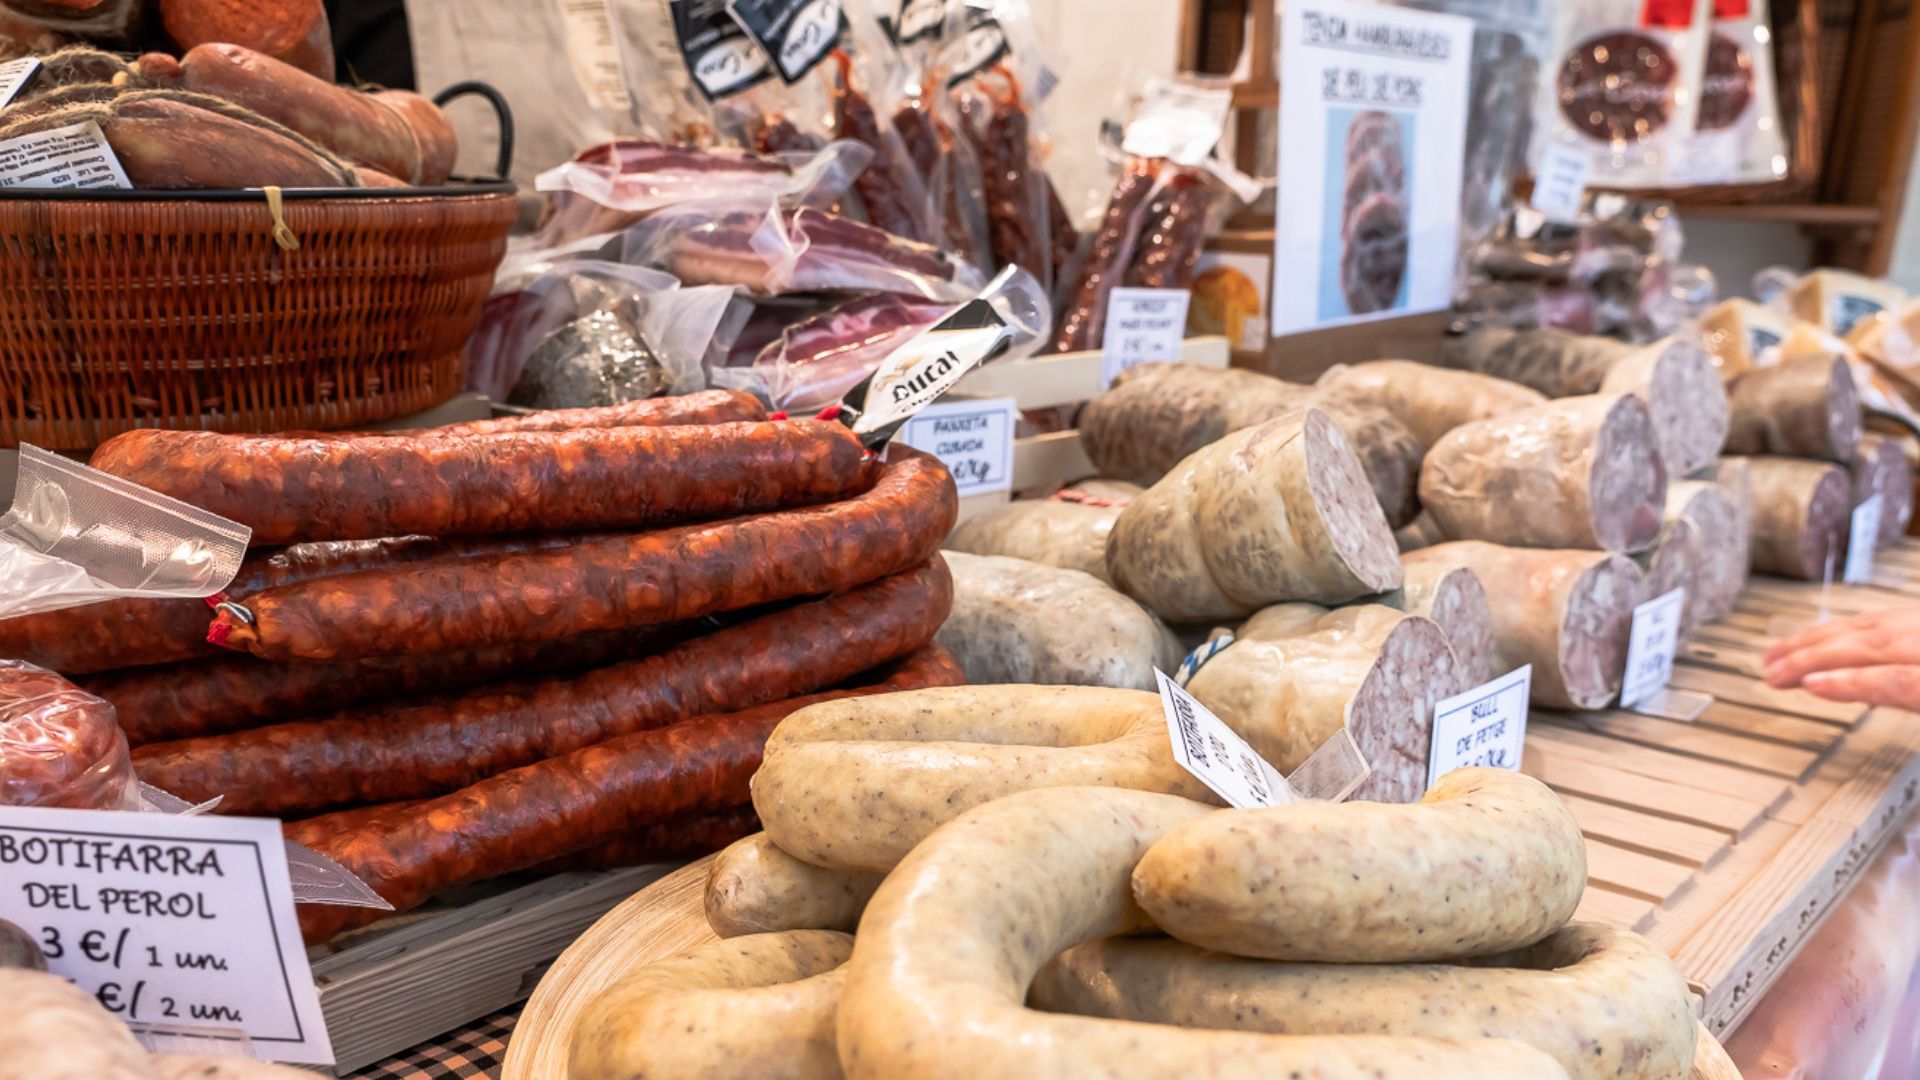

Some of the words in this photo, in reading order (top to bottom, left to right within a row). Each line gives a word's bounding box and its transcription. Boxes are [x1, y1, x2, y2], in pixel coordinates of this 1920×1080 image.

[0, 835, 225, 877] BOTIFARRA
[23, 882, 91, 911] DEL
[98, 888, 217, 919] PEROL
[161, 997, 180, 1018] 2
